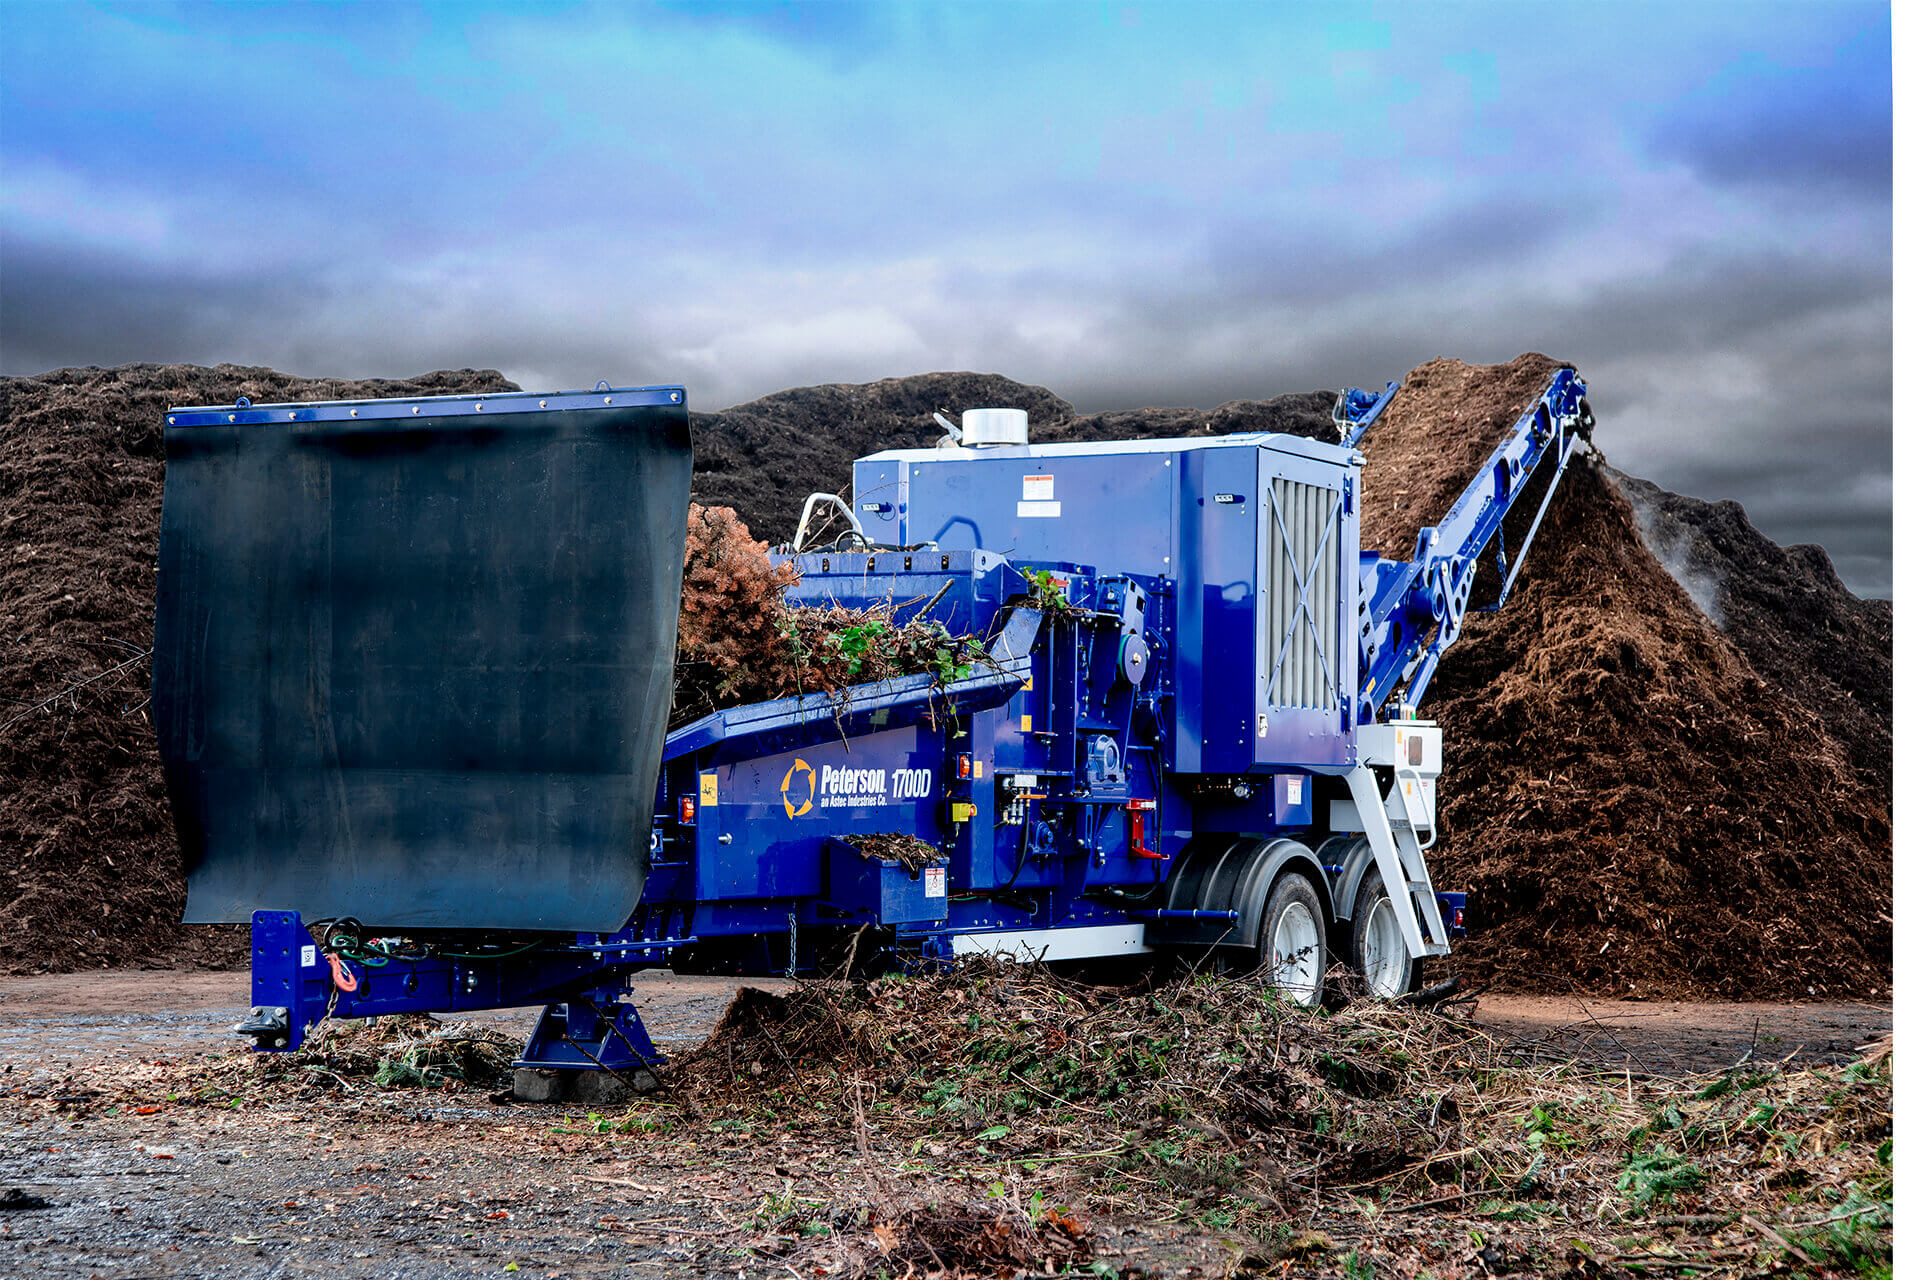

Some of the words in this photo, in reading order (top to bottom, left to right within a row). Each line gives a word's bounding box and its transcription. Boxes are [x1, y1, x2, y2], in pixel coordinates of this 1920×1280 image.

[891, 768, 931, 798] 1700D
[820, 797, 829, 807] an
[829, 795, 847, 807] Astec
[877, 794, 888, 806] Co.
